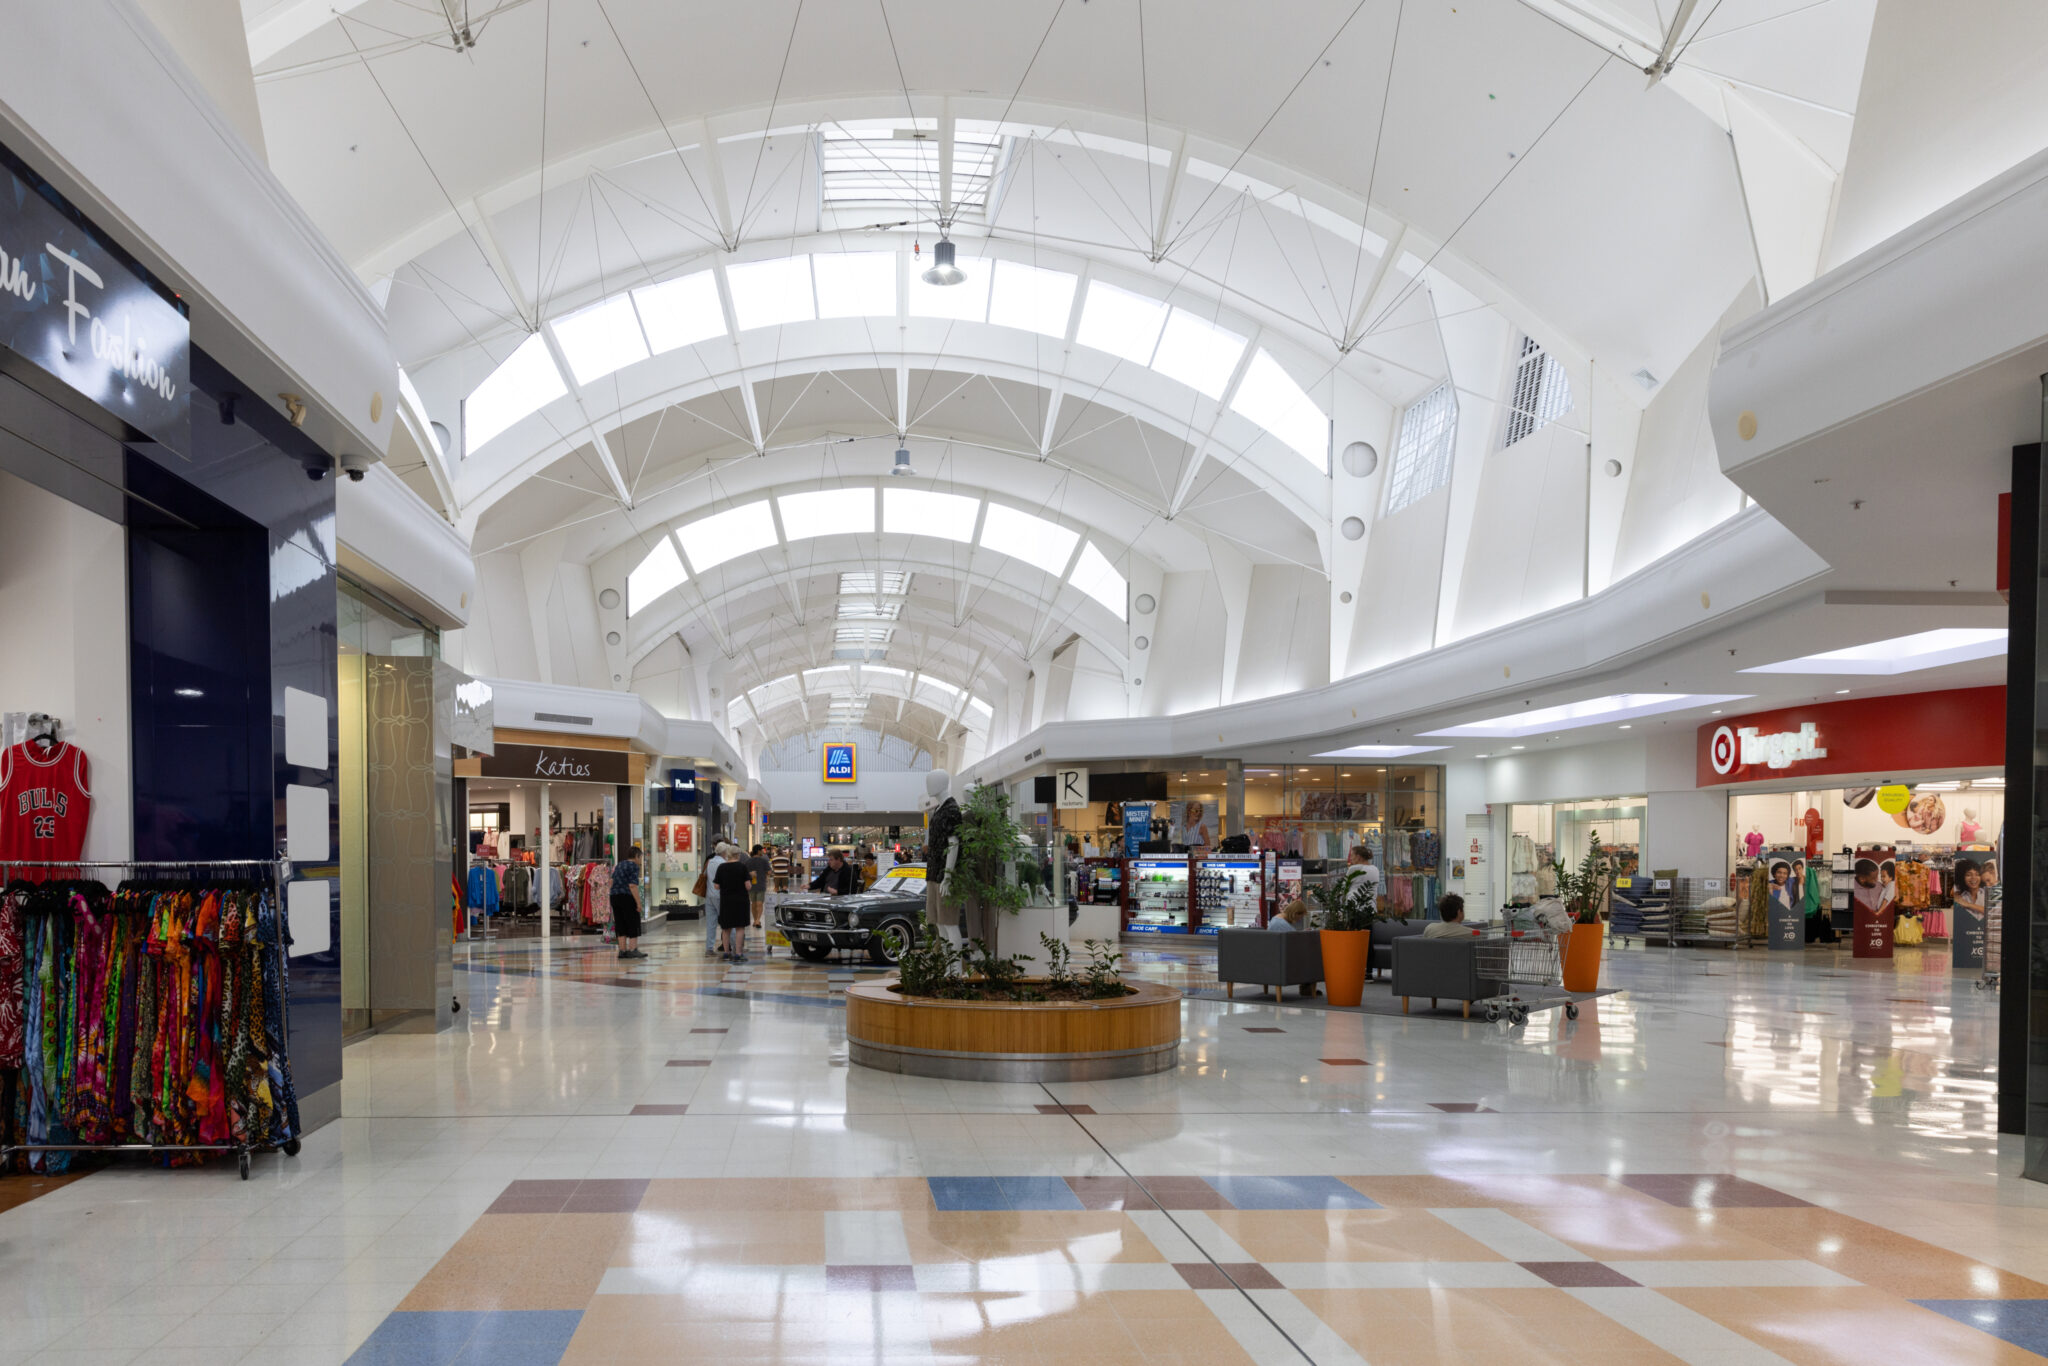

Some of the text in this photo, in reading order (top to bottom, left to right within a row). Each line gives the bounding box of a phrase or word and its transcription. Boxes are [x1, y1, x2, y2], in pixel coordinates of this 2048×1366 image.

[45, 241, 176, 401] Fashion
[535, 749, 590, 777] Katies
[829, 766, 851, 774] ALDI
[1059, 771, 1084, 801] R
[18, 787, 68, 818] BULS
[33, 815, 55, 838] 23
